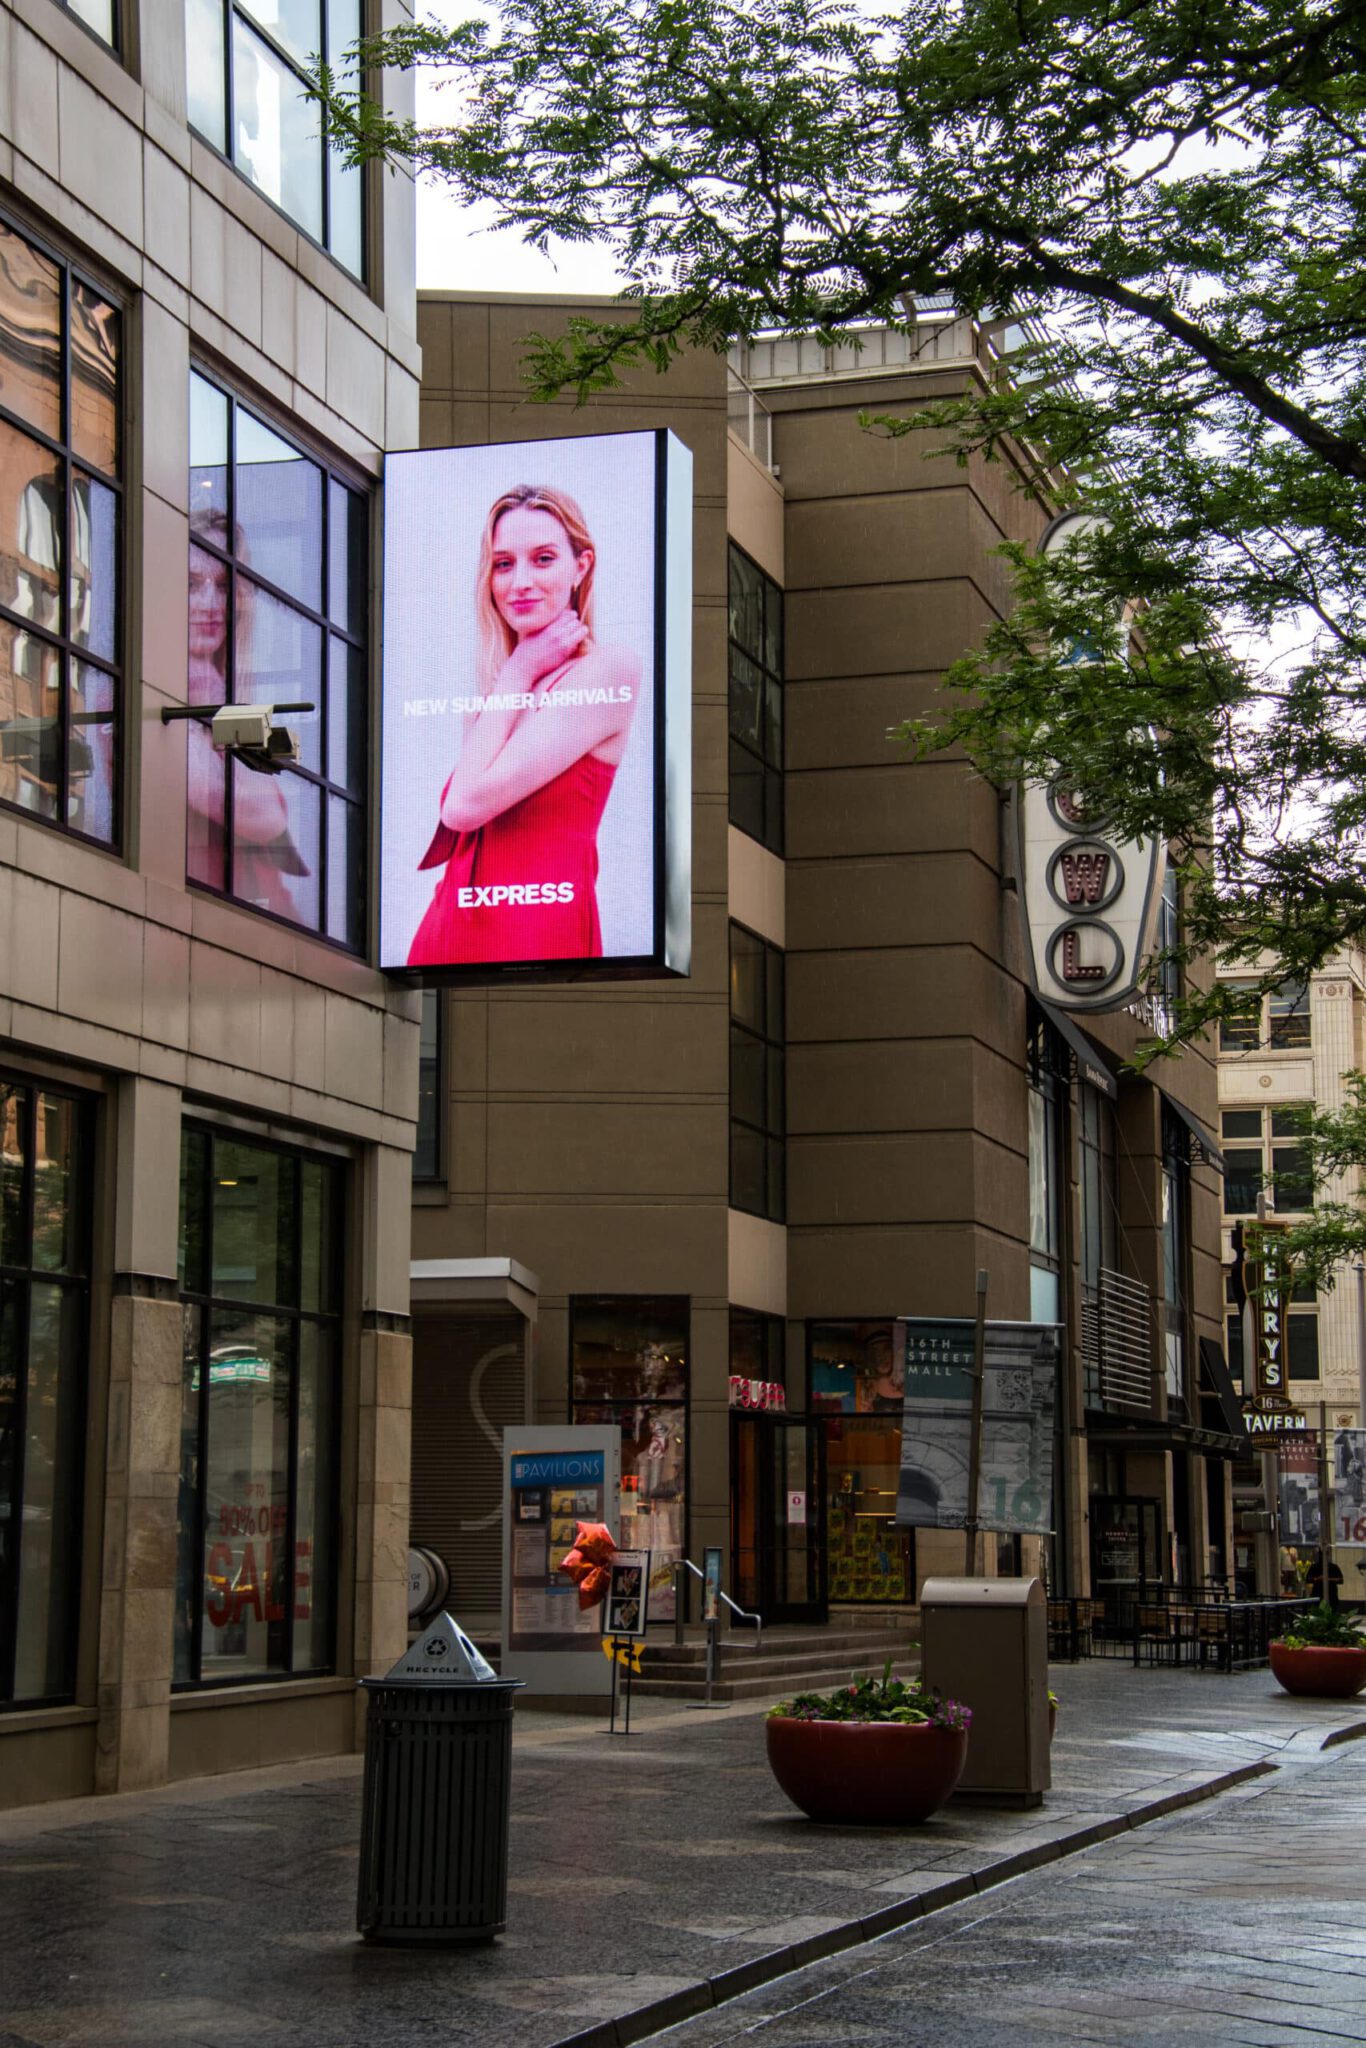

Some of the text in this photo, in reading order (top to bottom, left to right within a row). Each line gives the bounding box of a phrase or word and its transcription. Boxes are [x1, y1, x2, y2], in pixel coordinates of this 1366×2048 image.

[403, 685, 633, 717] NEW SUMMER ARRIVALS
[458, 882, 574, 908] EXPRESS
[909, 1338, 950, 1348] 16TH
[908, 1352, 972, 1363] STREET
[908, 1367, 952, 1376] MALL
[1242, 1414, 1306, 1432] TAVERN
[522, 1460, 600, 1479] PAVILIONS
[989, 1477, 1042, 1523] 16
[1341, 1517, 1366, 1542] 16
[207, 1541, 311, 1628] SALE
